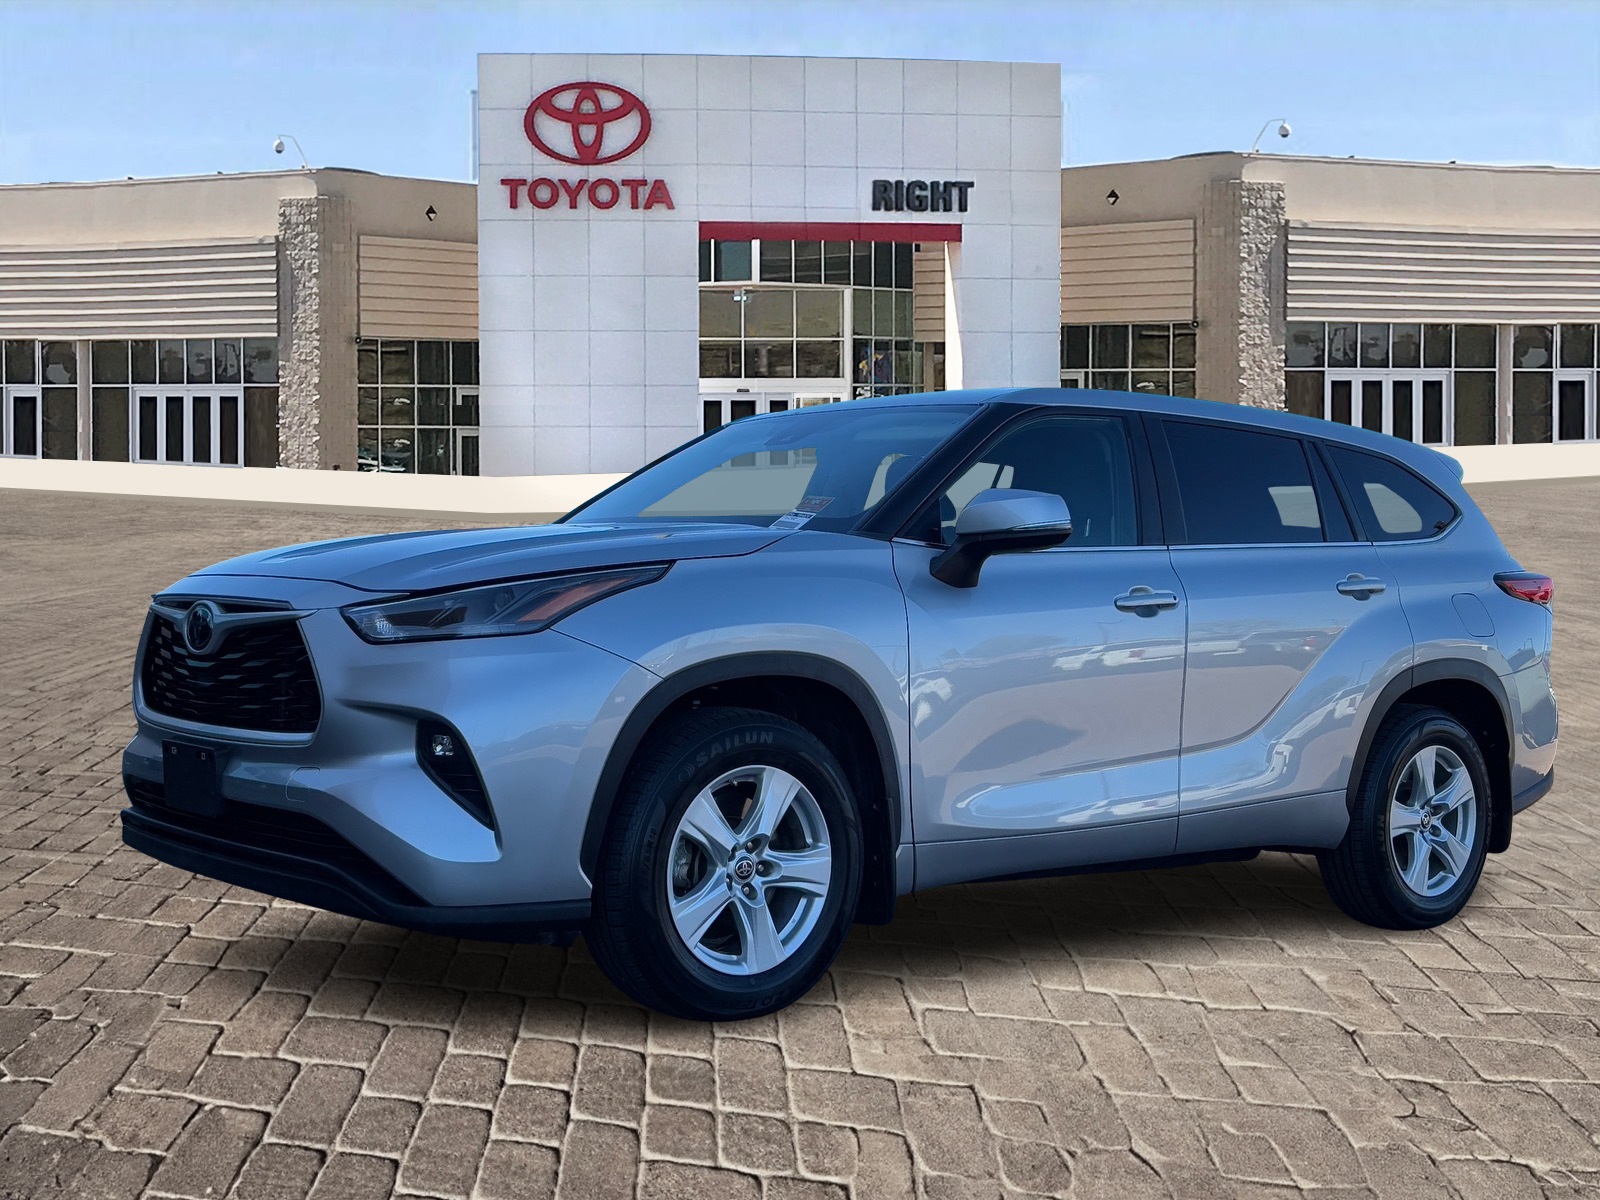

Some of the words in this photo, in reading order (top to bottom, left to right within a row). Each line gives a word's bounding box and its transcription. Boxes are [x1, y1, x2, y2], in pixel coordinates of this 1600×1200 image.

[500, 178, 675, 210] TOYOTA
[871, 179, 975, 213] RIGHT
[695, 730, 774, 768] SAILUN
